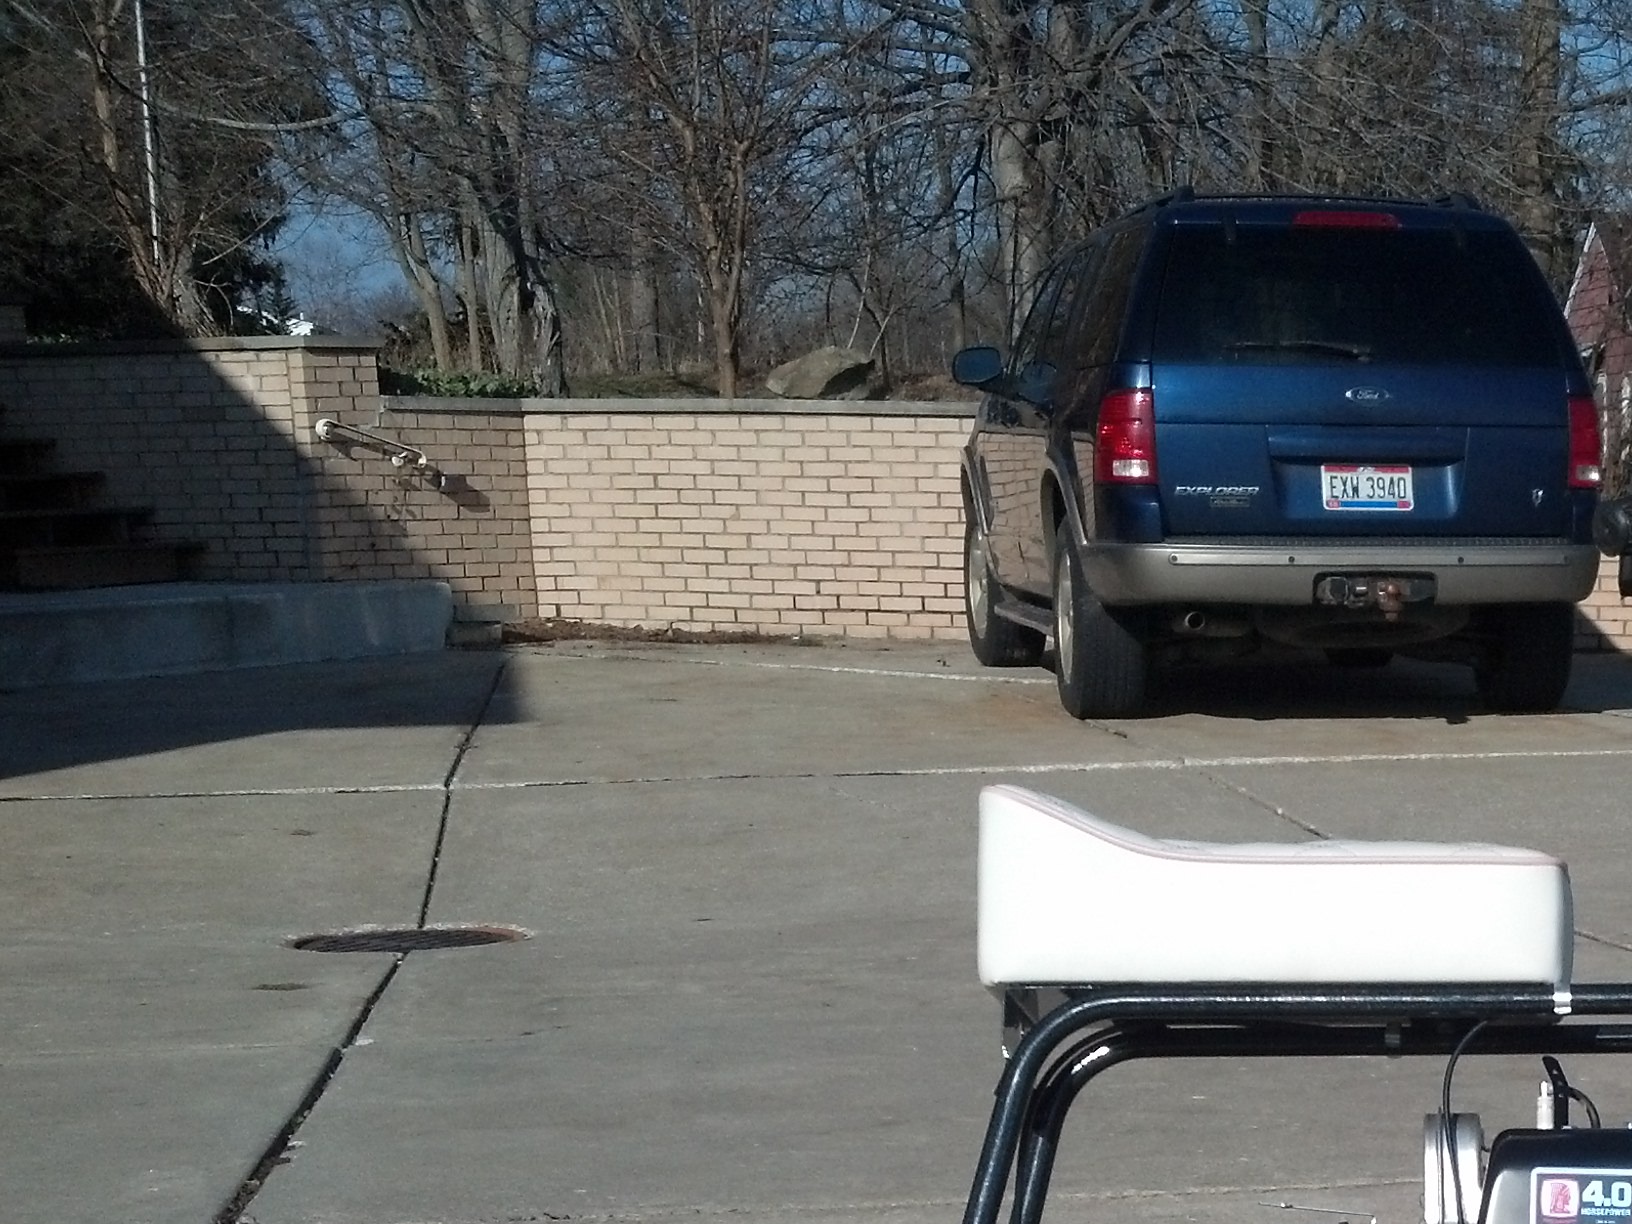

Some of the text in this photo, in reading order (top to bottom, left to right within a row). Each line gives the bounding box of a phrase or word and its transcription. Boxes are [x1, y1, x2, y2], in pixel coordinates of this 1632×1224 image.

[1174, 486, 1260, 496] EXPLORER
[1329, 475, 1407, 499] EXW 3940
[1581, 1180, 1632, 1207] 4.0
